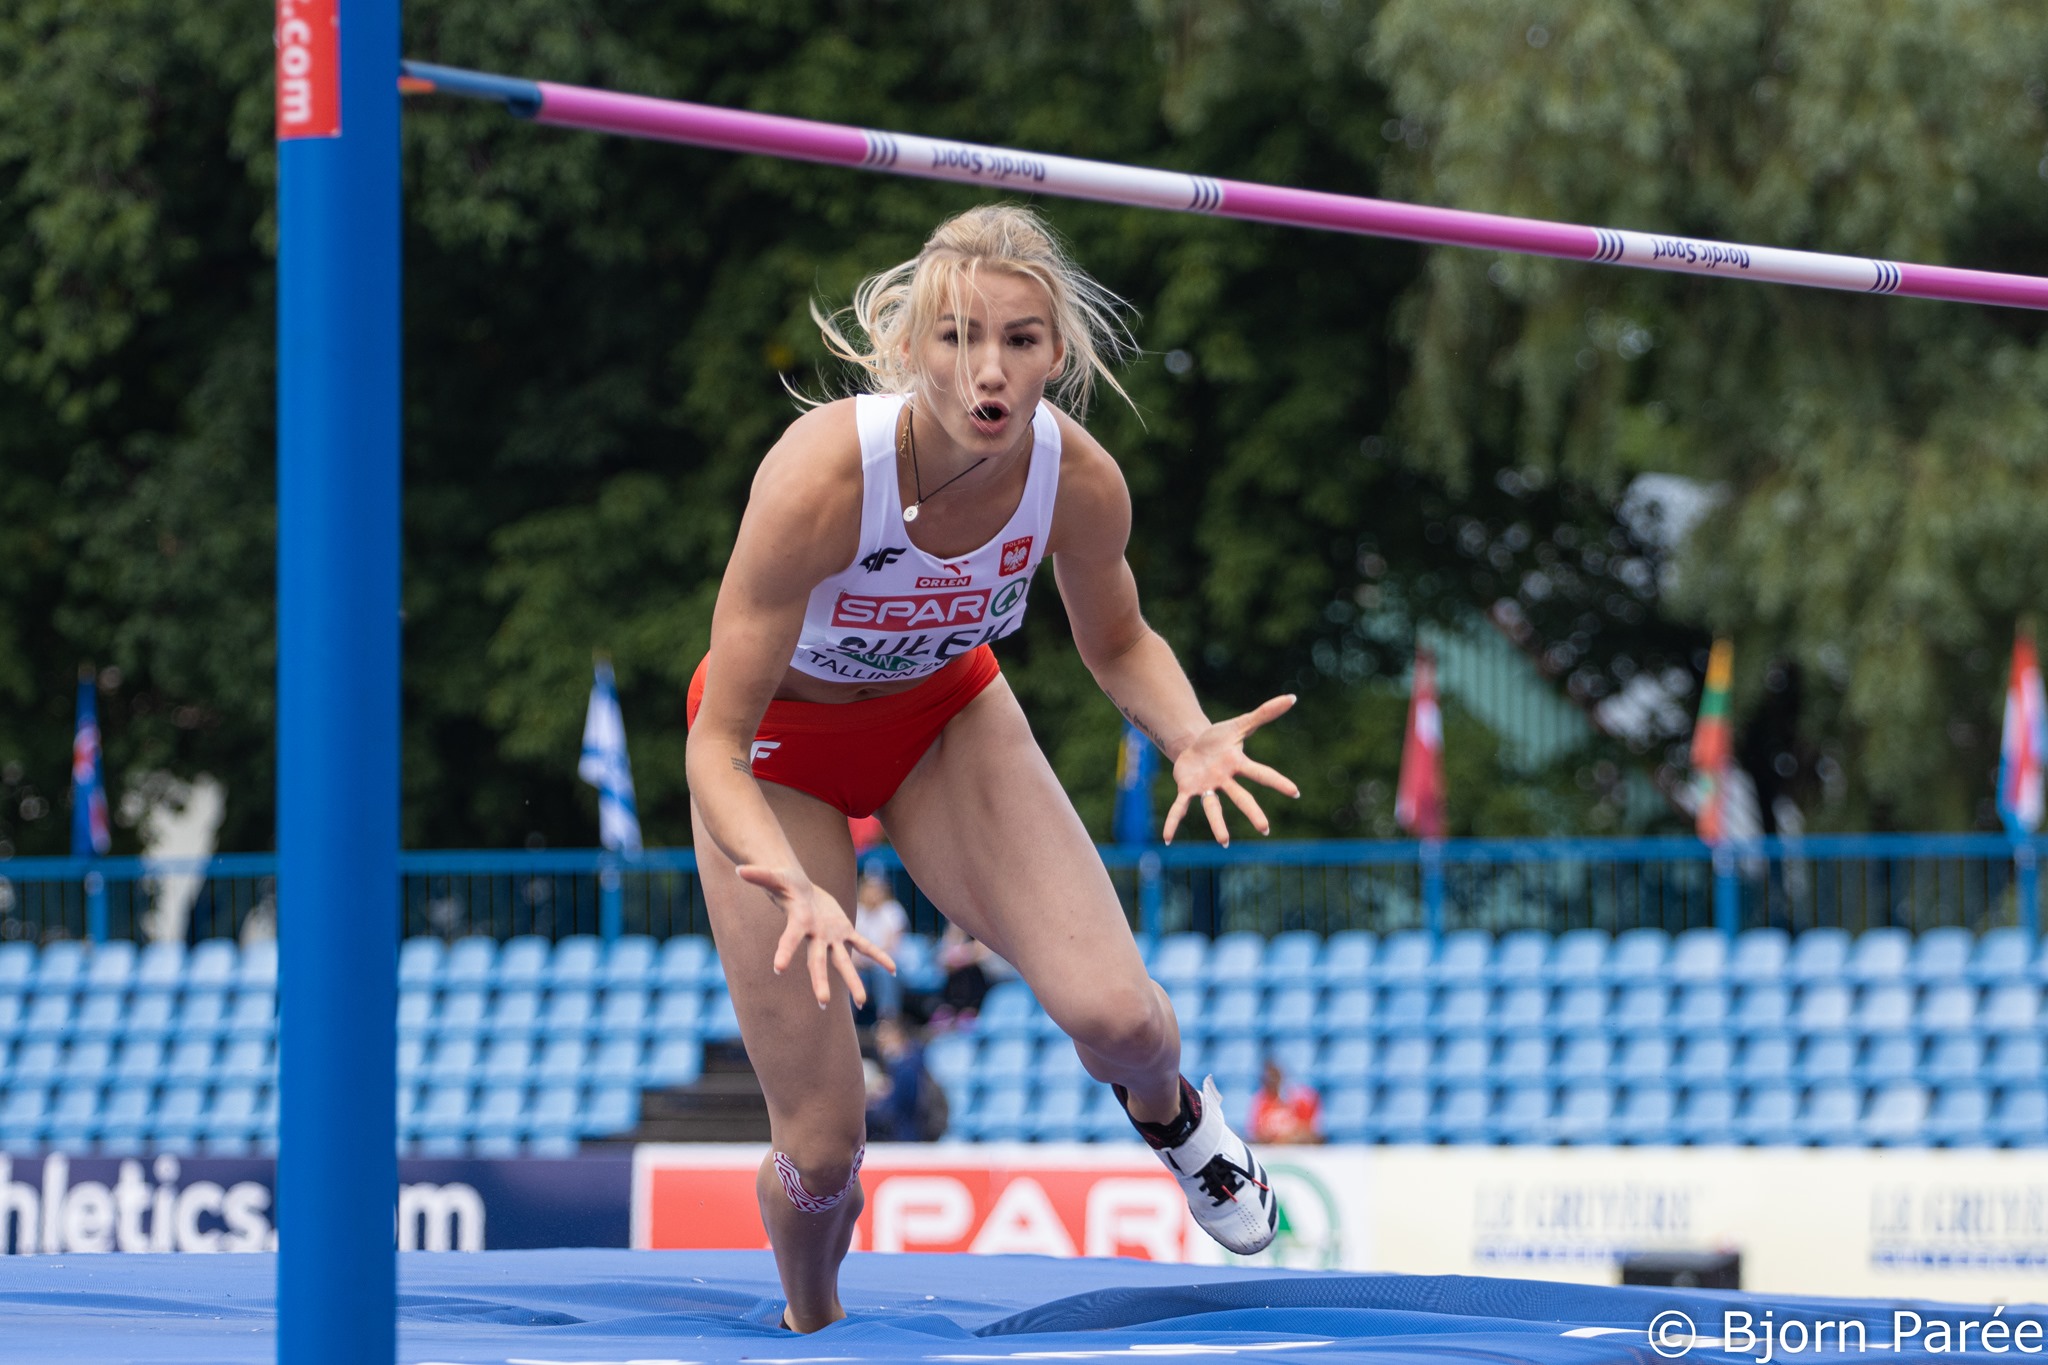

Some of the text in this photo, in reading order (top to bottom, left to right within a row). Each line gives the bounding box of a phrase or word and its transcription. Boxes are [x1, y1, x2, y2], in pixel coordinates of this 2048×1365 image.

[281, 0, 311, 124] .com
[1004, 537, 1031, 549] POLSKA
[919, 577, 969, 588] ORLEN
[838, 595, 985, 627] SPAR
[810, 650, 916, 680] TALLINN
[764, 1174, 1186, 1264] PAR
